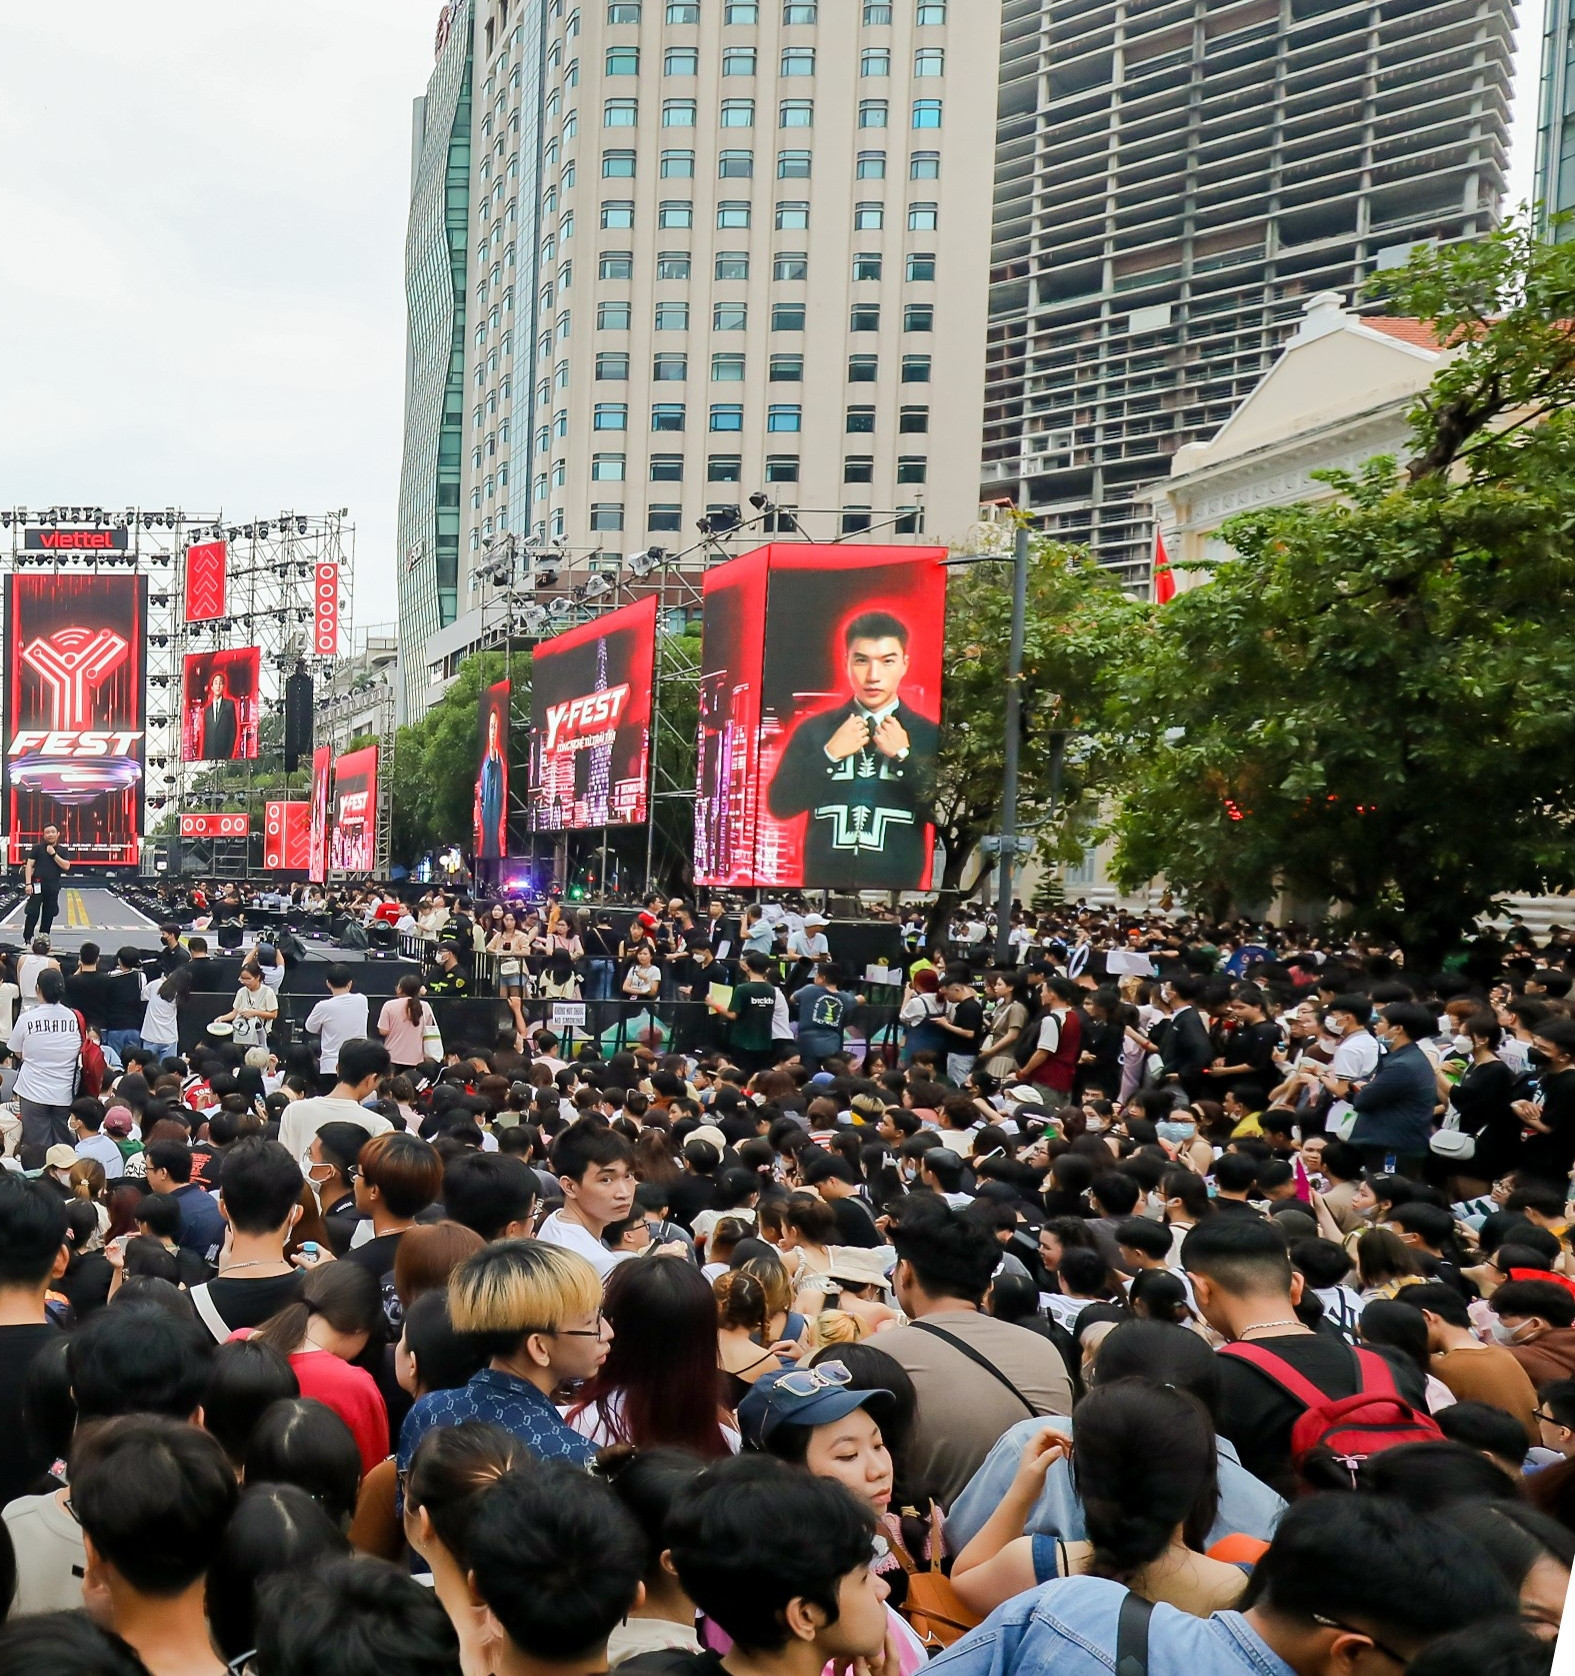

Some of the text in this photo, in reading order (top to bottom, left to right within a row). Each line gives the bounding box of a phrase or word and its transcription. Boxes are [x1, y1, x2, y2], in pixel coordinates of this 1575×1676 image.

[40, 531, 113, 548] viettel
[546, 687, 627, 749] Y-FEST
[7, 731, 144, 755] FEST
